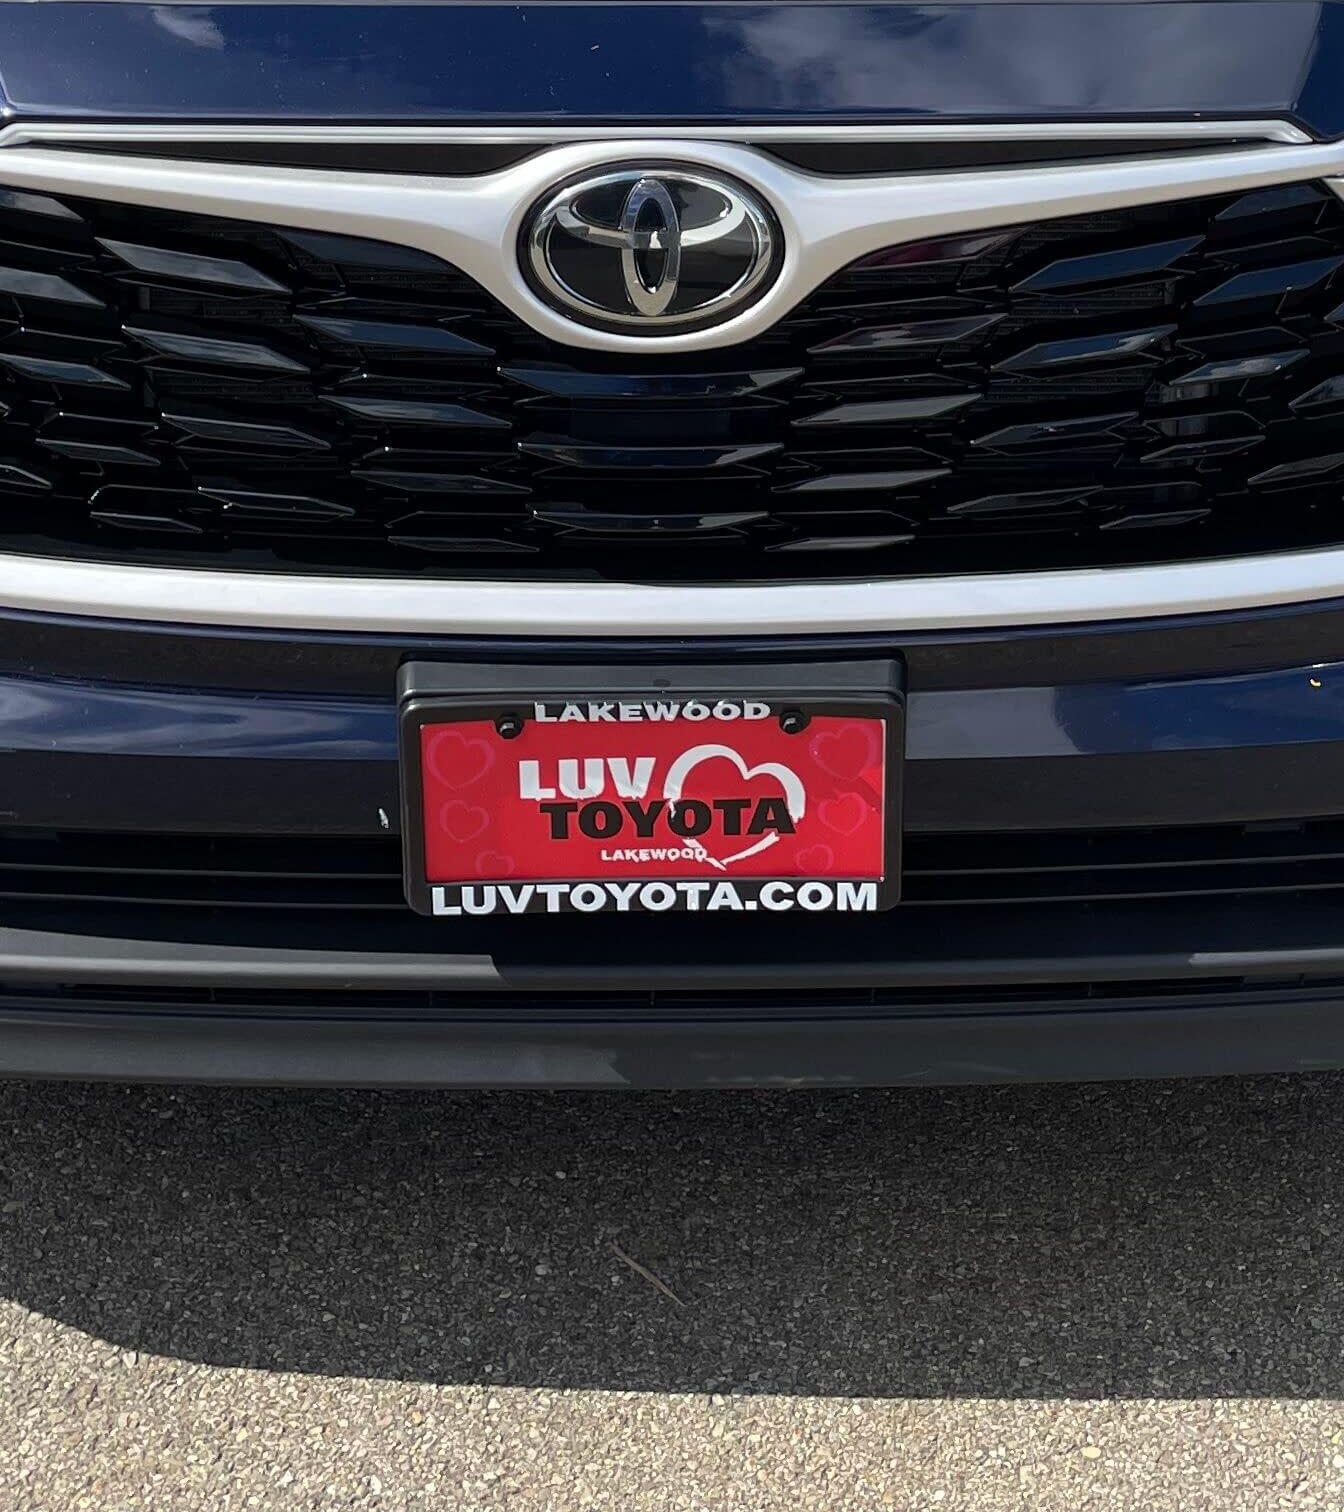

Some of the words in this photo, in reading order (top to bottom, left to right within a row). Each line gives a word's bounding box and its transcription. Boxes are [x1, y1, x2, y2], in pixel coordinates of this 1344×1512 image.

[534, 700, 772, 723] LAKEWOOD
[518, 756, 657, 801] LUV
[539, 797, 796, 840] TOYOTA
[600, 846, 708, 862] LAKEWOOD
[431, 881, 878, 916] LUVTOYOTA.COM
